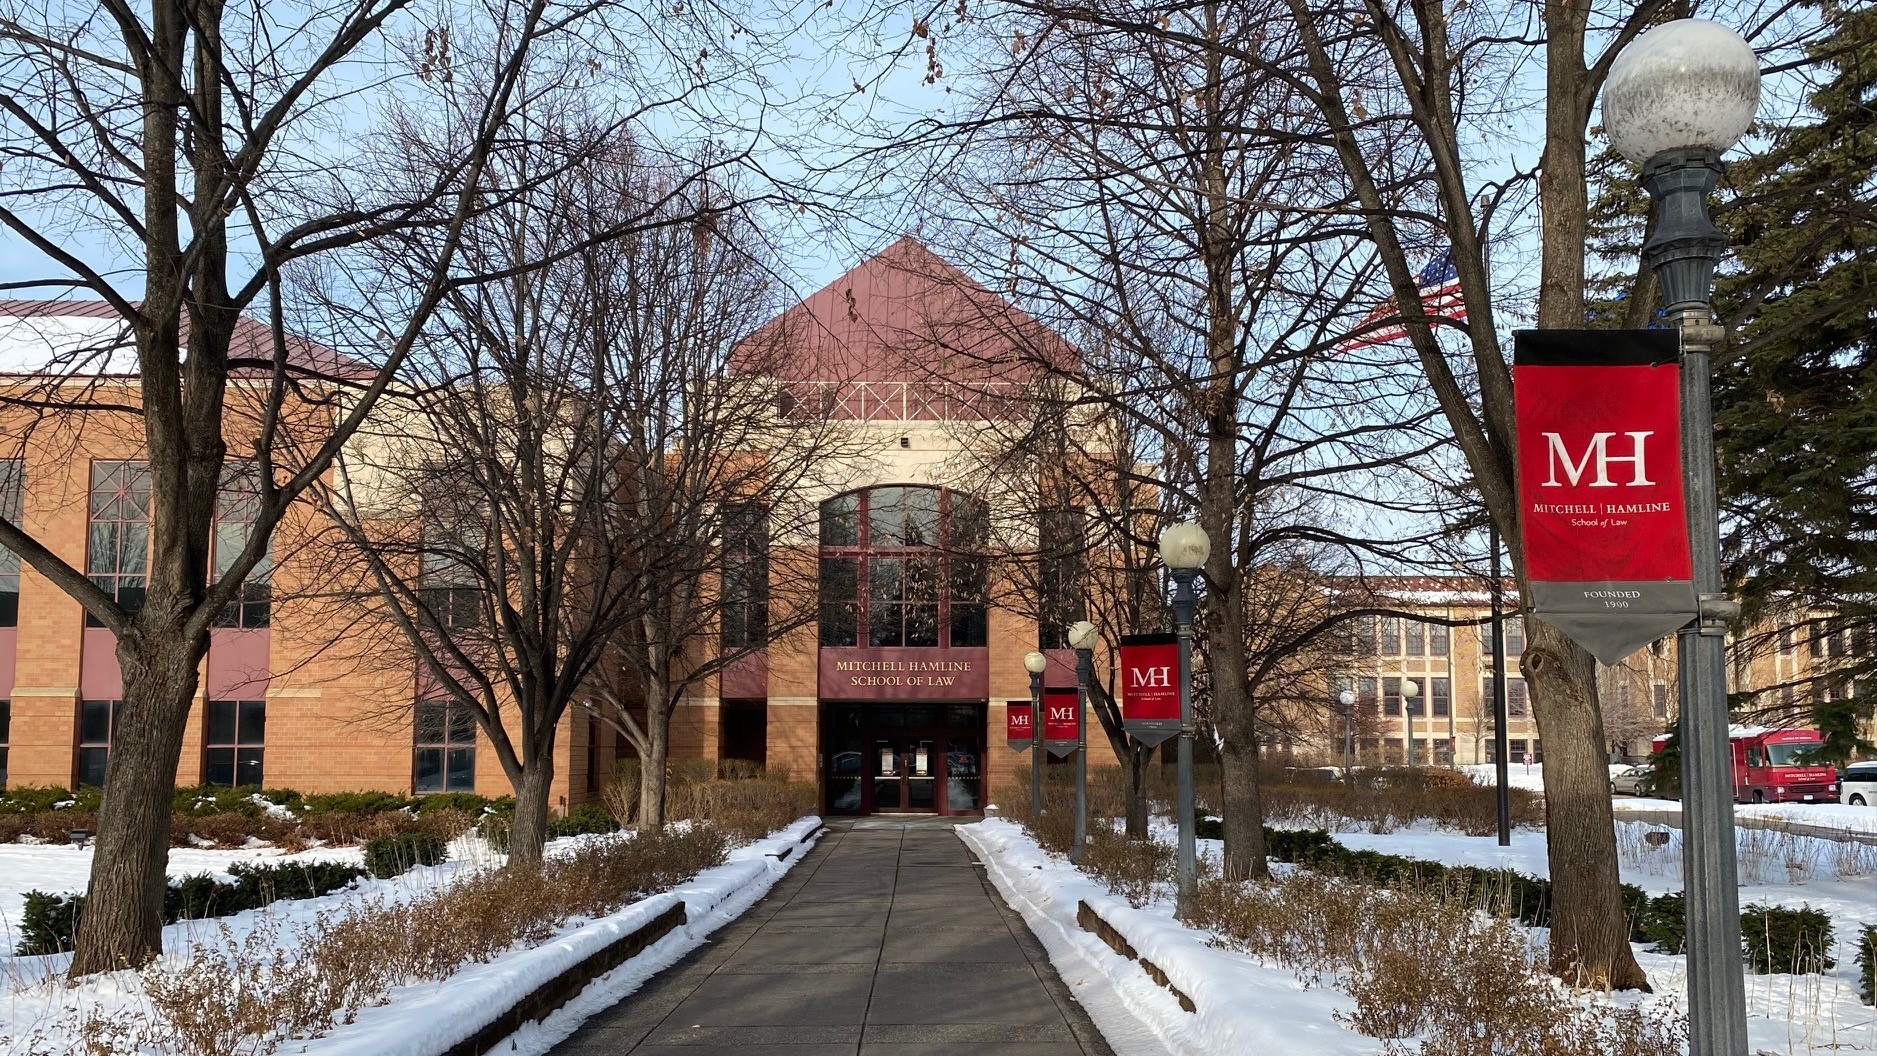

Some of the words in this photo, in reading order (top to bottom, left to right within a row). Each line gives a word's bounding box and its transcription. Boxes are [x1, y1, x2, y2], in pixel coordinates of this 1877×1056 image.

[1541, 431, 1656, 487] MH
[1533, 503, 1597, 514] MITCHELL
[1606, 502, 1671, 514] HAMLINE
[1571, 518, 1598, 527] School
[1600, 518, 1609, 528] of
[1611, 518, 1628, 526] Law
[1583, 590, 1640, 599] FOUNDED
[1605, 600, 1629, 609] 1900
[836, 661, 905, 672] MITCHELL
[909, 661, 971, 672] HAMLINE
[851, 676, 903, 686] SCHOOL
[906, 676, 924, 686] OF
[928, 676, 956, 686] LAW
[1130, 666, 1172, 688] MH
[1050, 707, 1075, 720] MH
[1011, 715, 1030, 725] MH
